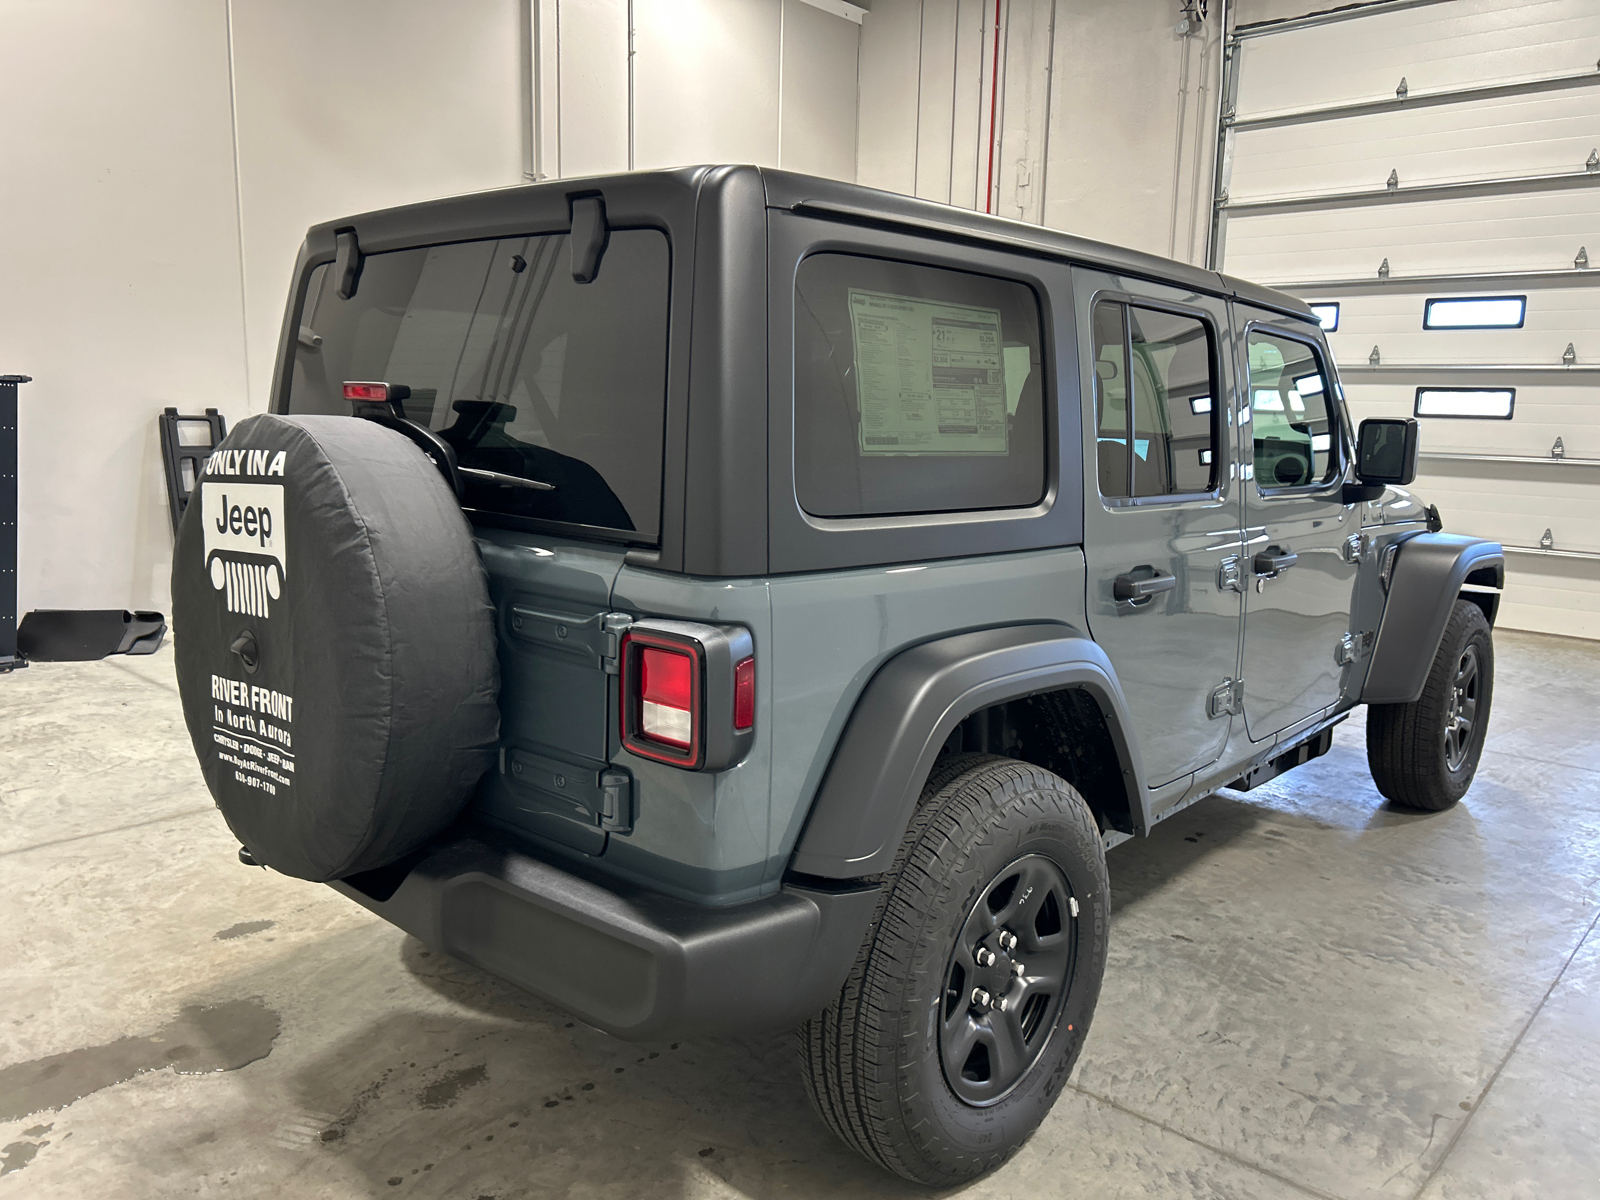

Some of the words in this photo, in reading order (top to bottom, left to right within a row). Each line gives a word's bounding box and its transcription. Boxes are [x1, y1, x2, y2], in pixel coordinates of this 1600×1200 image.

[206, 450, 246, 476] ONLY
[246, 450, 269, 476] IN
[267, 451, 287, 477] A
[216, 494, 272, 548] Jeep
[211, 674, 250, 708] RIVER
[251, 685, 293, 723] FRONT
[214, 704, 224, 723] In
[226, 708, 257, 733] North
[259, 719, 292, 748] Aurora
[213, 733, 239, 752] CHRYSLER
[243, 743, 264, 759] DODGE
[266, 751, 280, 765] JEEP
[281, 758, 295, 773] RAM
